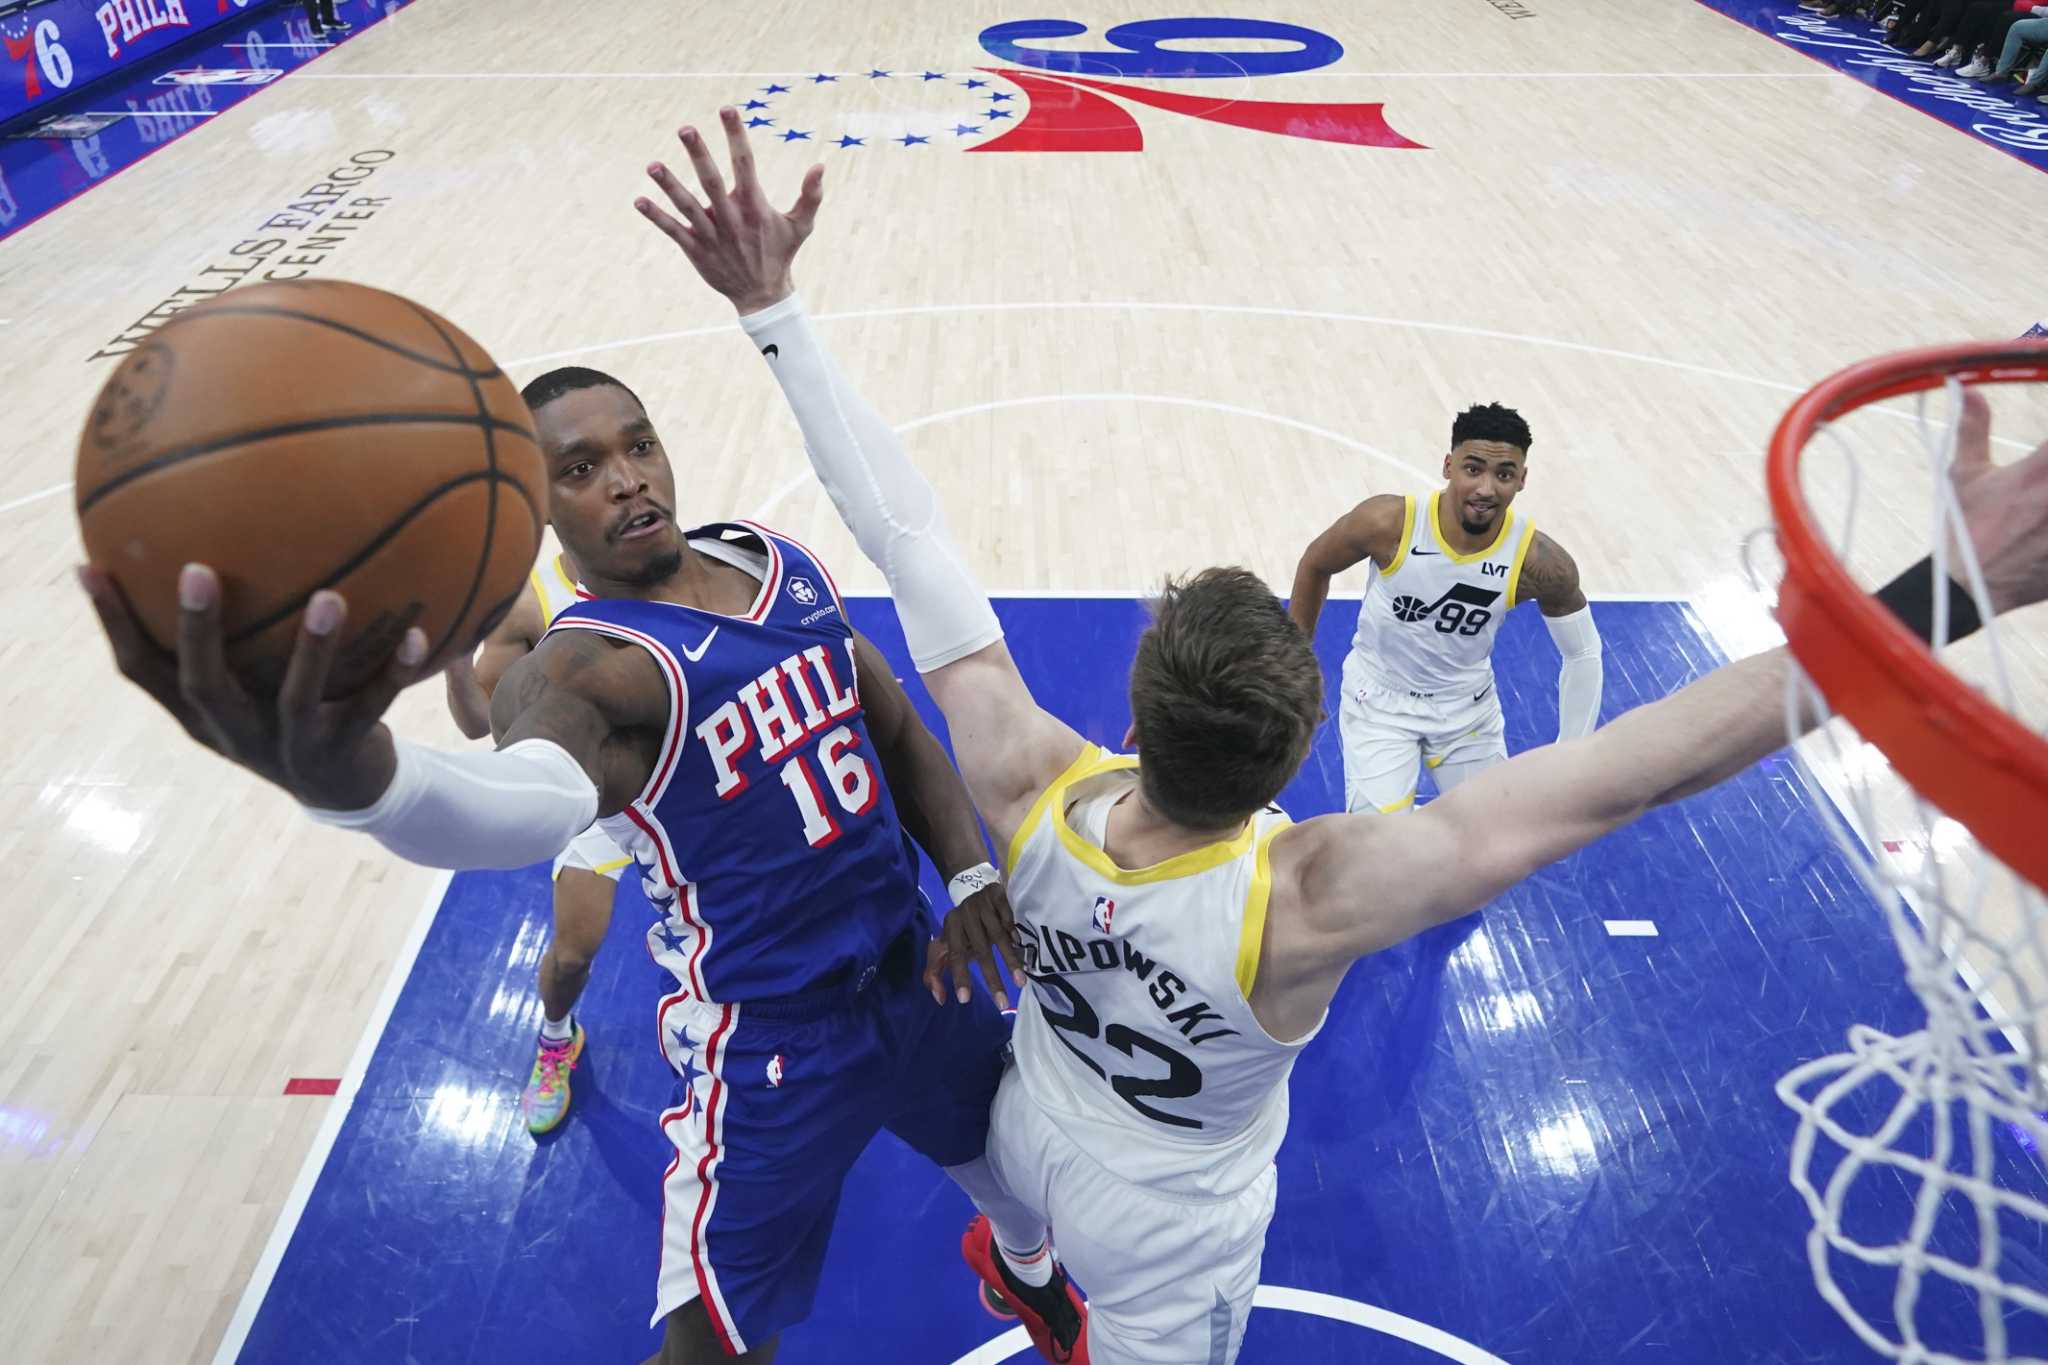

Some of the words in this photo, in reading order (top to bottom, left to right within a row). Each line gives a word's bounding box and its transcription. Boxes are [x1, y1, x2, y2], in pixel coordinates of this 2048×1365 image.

[257, 149, 395, 231] FARGO
[263, 196, 392, 281] CENTER
[1481, 561, 1508, 578] LVT
[801, 605, 837, 625] crypto.com
[1434, 602, 1492, 636] 99
[780, 725, 879, 848] 16
[1026, 970, 1203, 1129] 22
